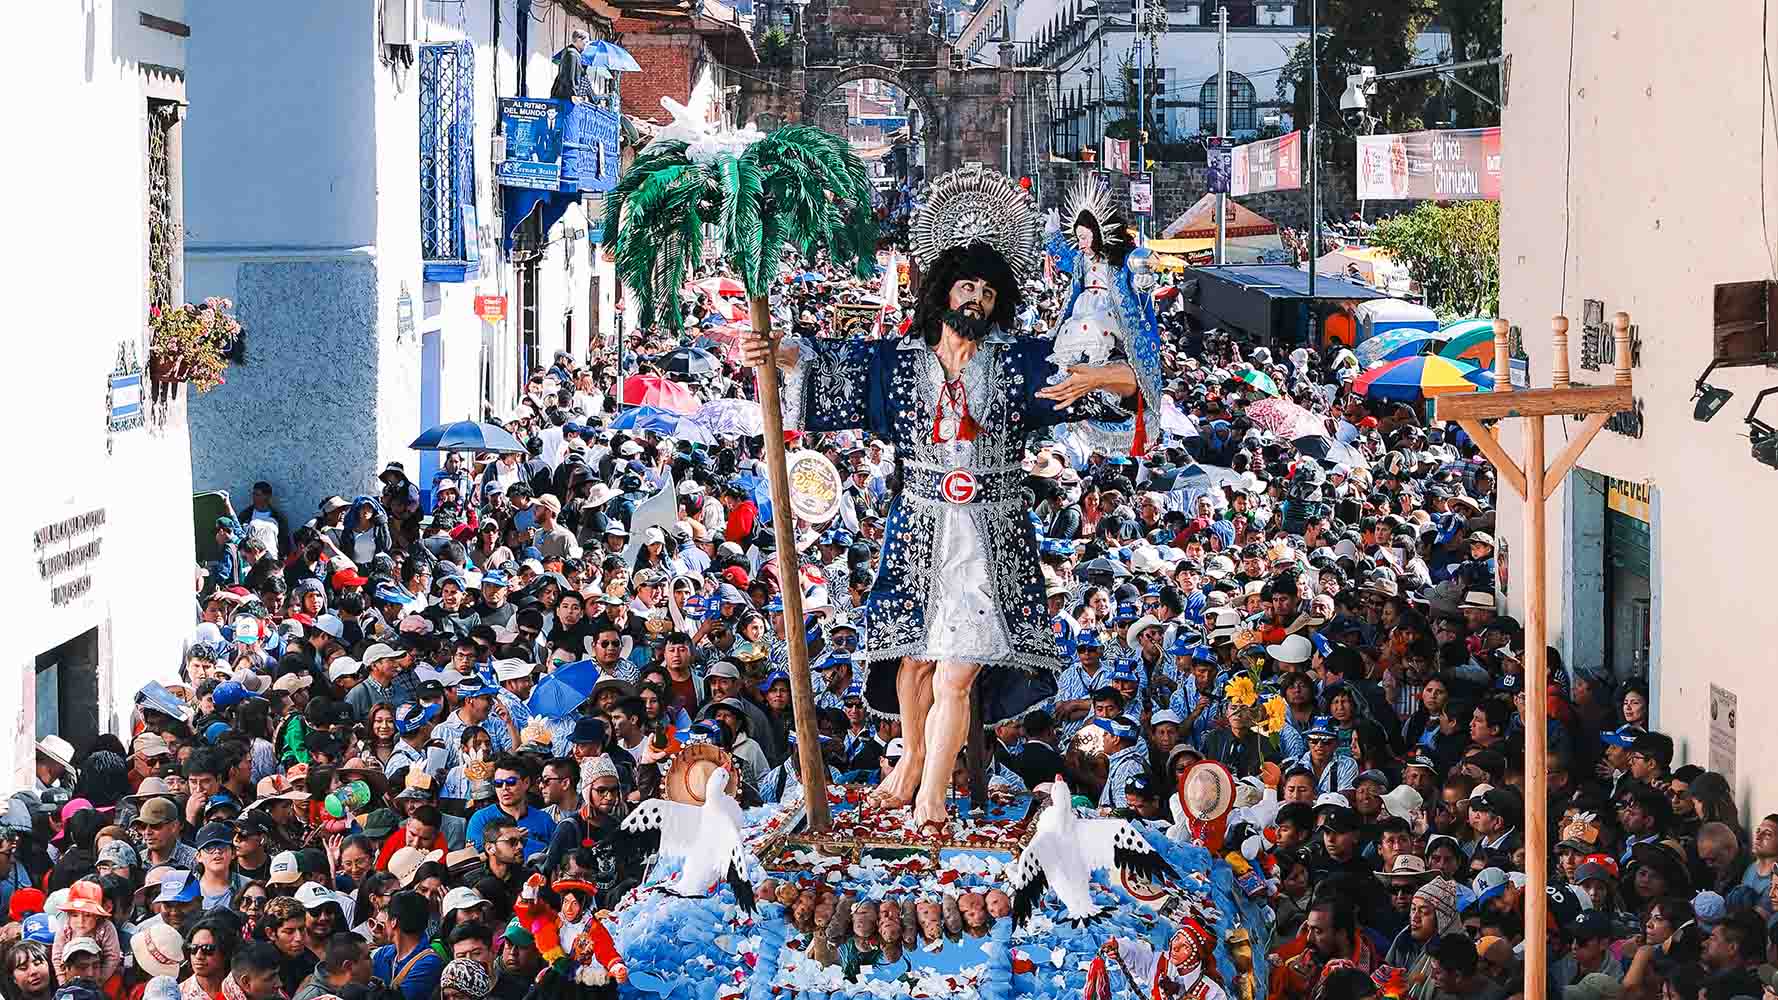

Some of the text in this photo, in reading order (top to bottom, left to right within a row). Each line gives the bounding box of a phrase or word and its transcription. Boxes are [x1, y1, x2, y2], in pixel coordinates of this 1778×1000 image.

[504, 106, 546, 117] DEL MUNDO
[524, 102, 547, 110] RITMO
[1433, 135, 1444, 161] del
[1446, 133, 1460, 161] rico
[945, 471, 975, 500] G
